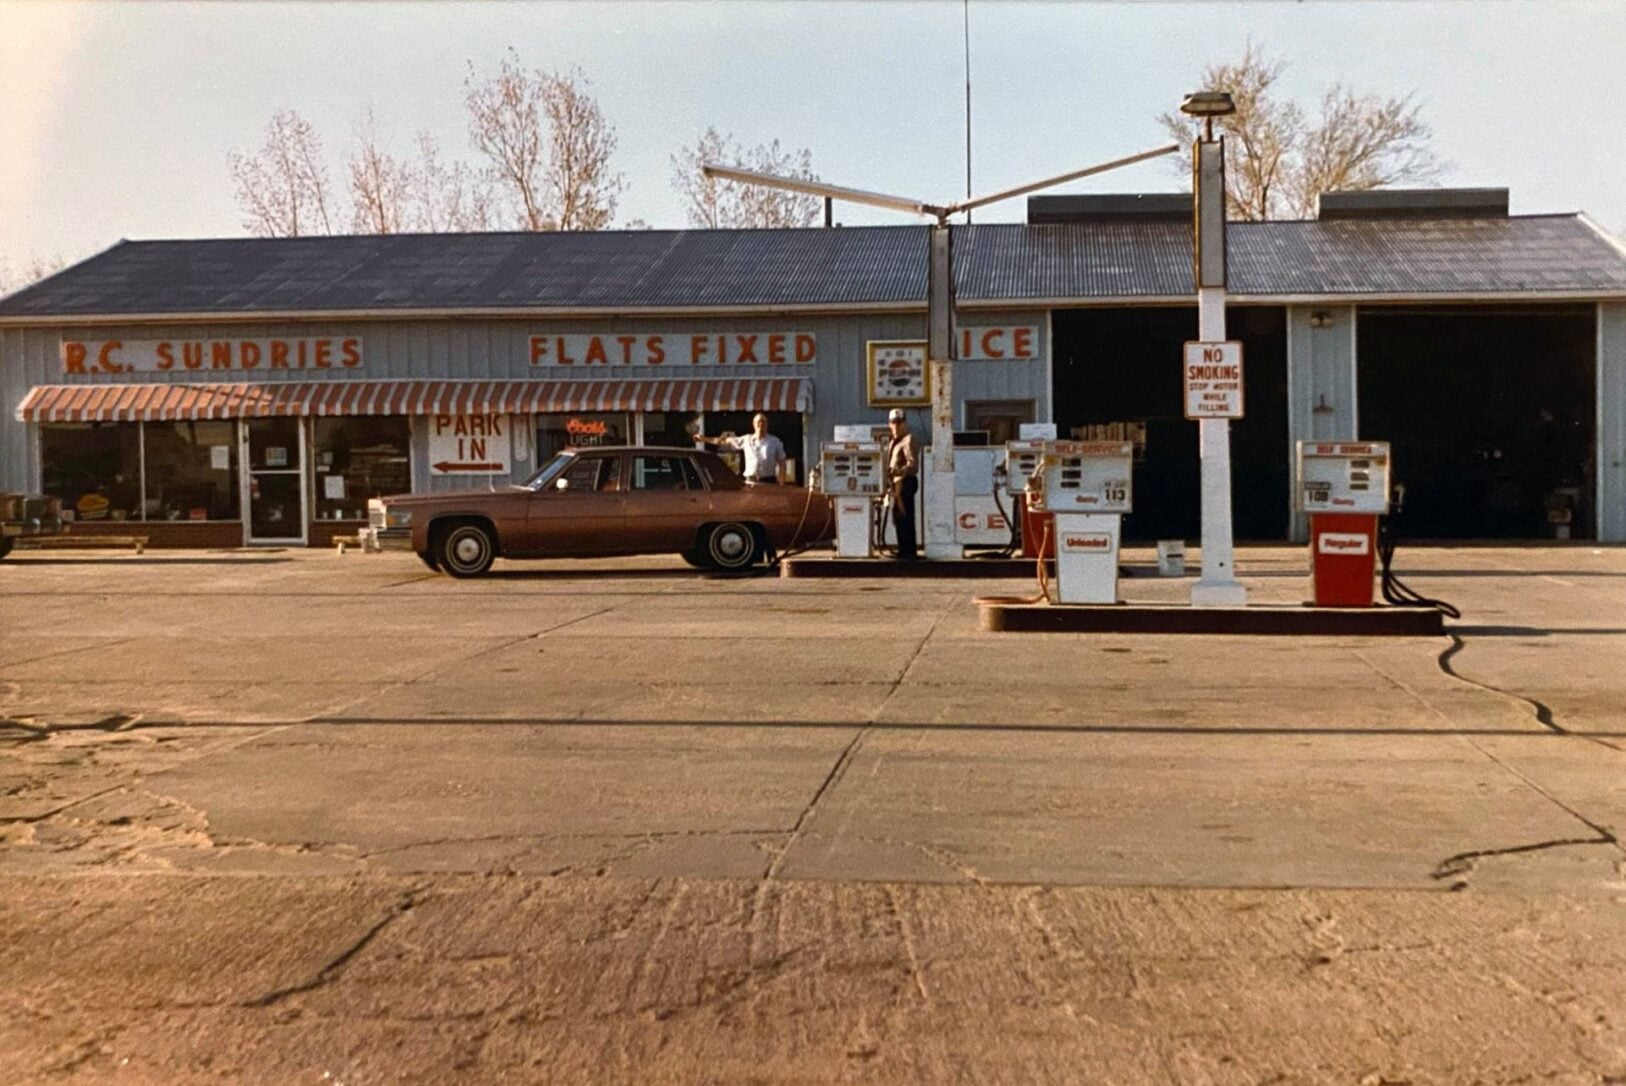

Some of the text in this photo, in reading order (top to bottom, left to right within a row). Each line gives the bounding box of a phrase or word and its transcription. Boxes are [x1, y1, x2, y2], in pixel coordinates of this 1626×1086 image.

[530, 334, 816, 365] FLATS FIXED
[963, 327, 1032, 358] ICE
[66, 338, 360, 373] R.C. SUNDRIES
[1203, 348, 1223, 363] NO
[1189, 366, 1239, 380] SMOKING
[1189, 383, 1238, 391] STOP MOTOR
[1203, 393, 1226, 402] WHILE
[1198, 403, 1229, 412] FILLING
[436, 413, 502, 436] PARK
[458, 438, 485, 461] IN
